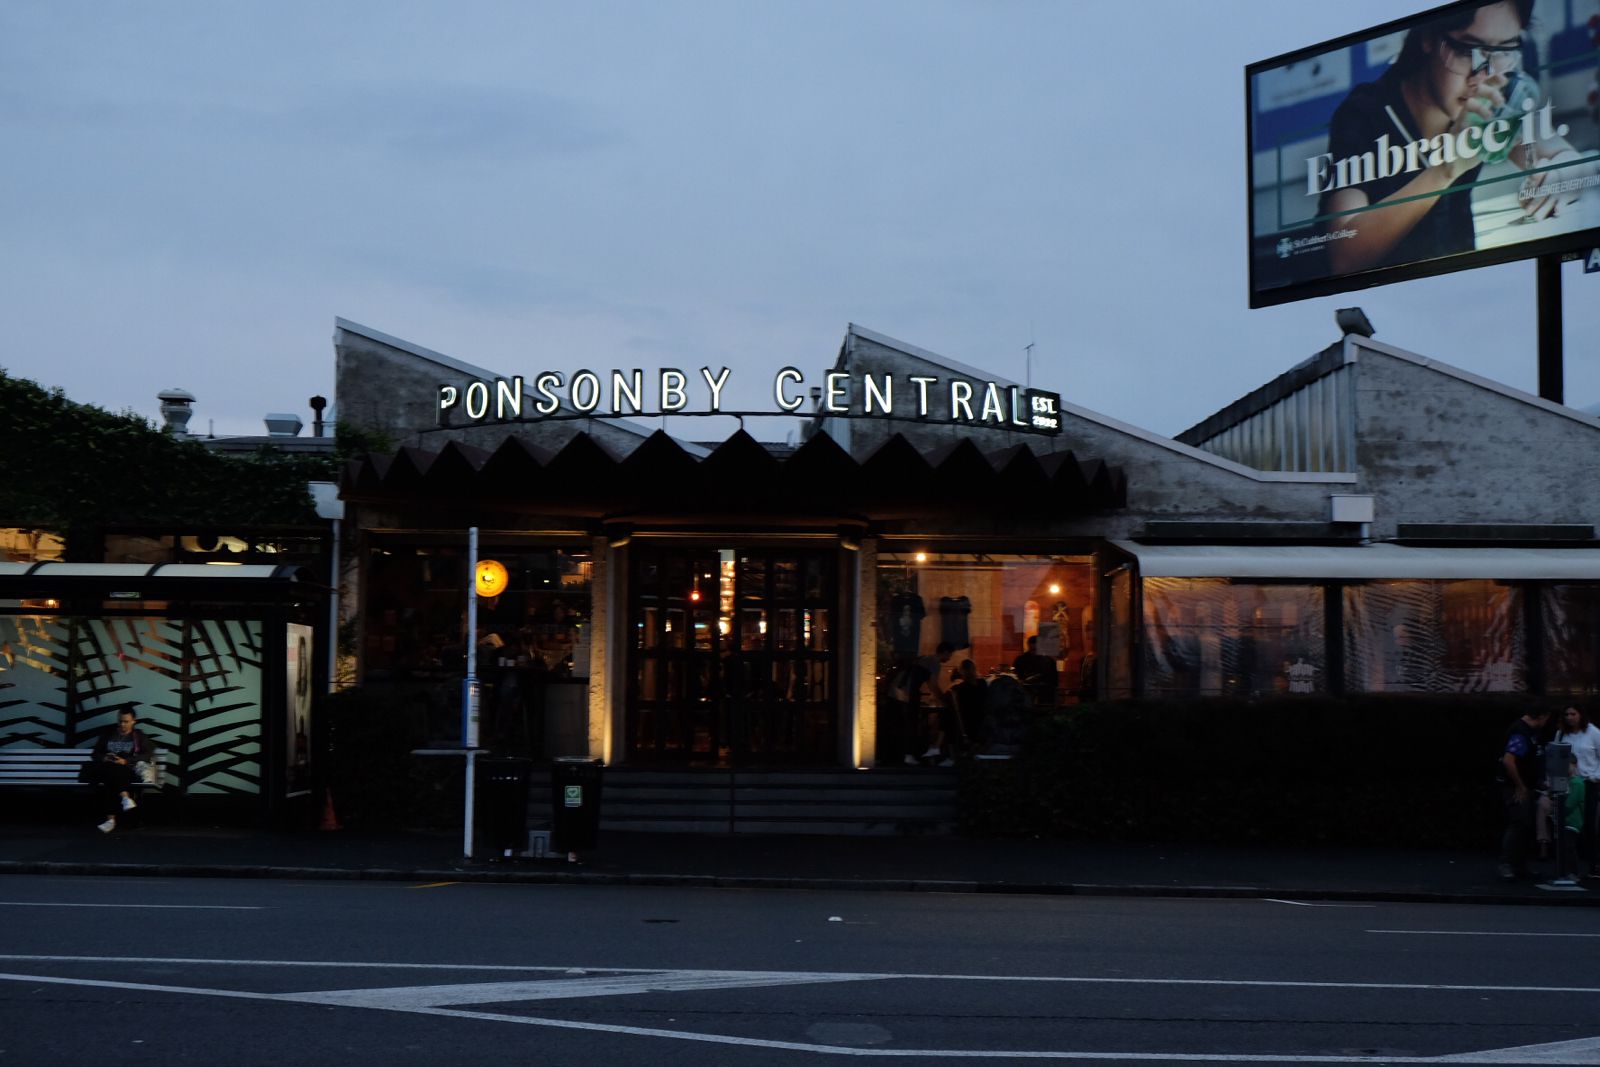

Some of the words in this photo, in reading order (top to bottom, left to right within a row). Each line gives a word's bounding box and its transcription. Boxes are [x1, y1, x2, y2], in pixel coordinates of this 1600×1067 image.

[1304, 118, 1511, 196] Embrace
[1519, 96, 1570, 146] it.
[437, 366, 731, 424] PONSONBY
[774, 366, 1030, 427] CENTRAL
